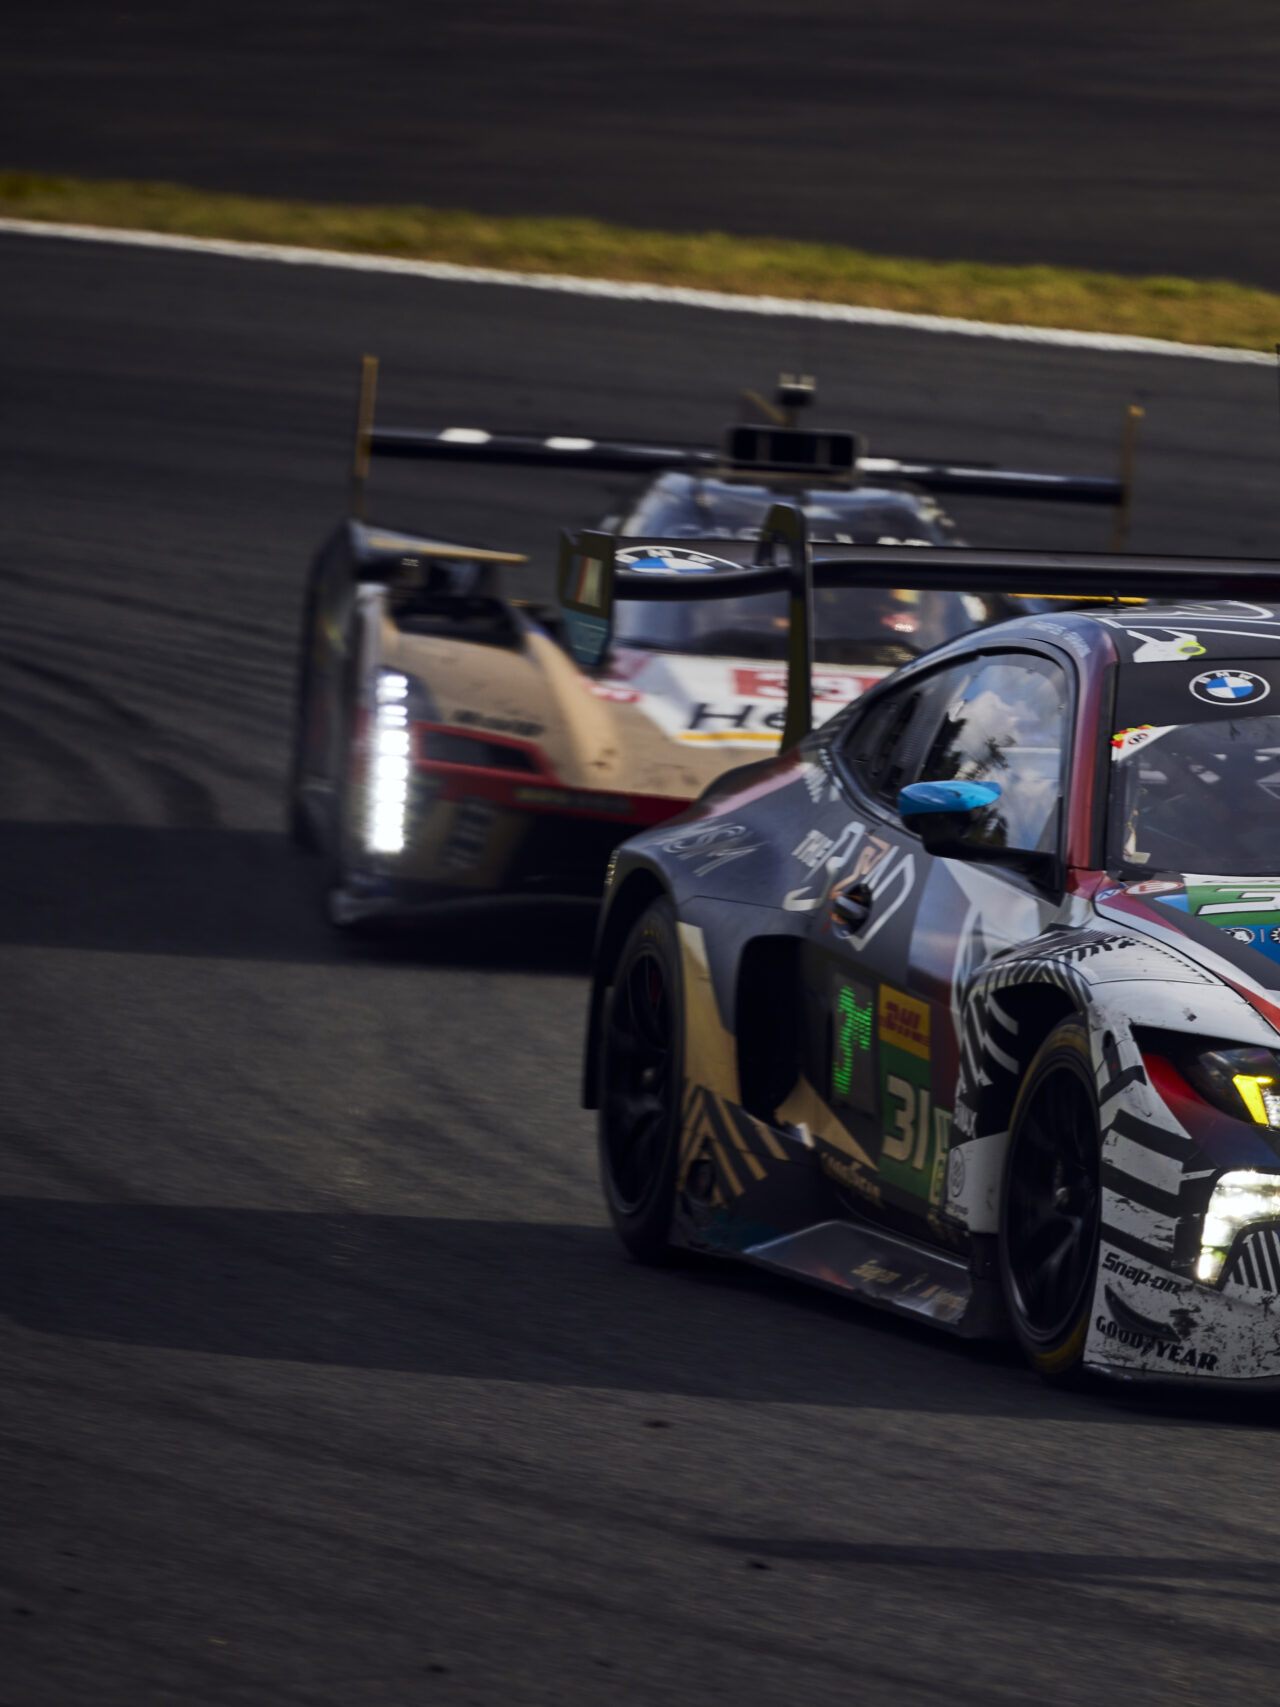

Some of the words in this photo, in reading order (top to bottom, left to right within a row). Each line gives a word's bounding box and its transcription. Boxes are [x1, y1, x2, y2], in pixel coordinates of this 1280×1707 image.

[882, 1073, 931, 1171] 31
[1102, 1251, 1181, 1294] Snap-on
[1095, 1315, 1218, 1371] GOODYEAR
